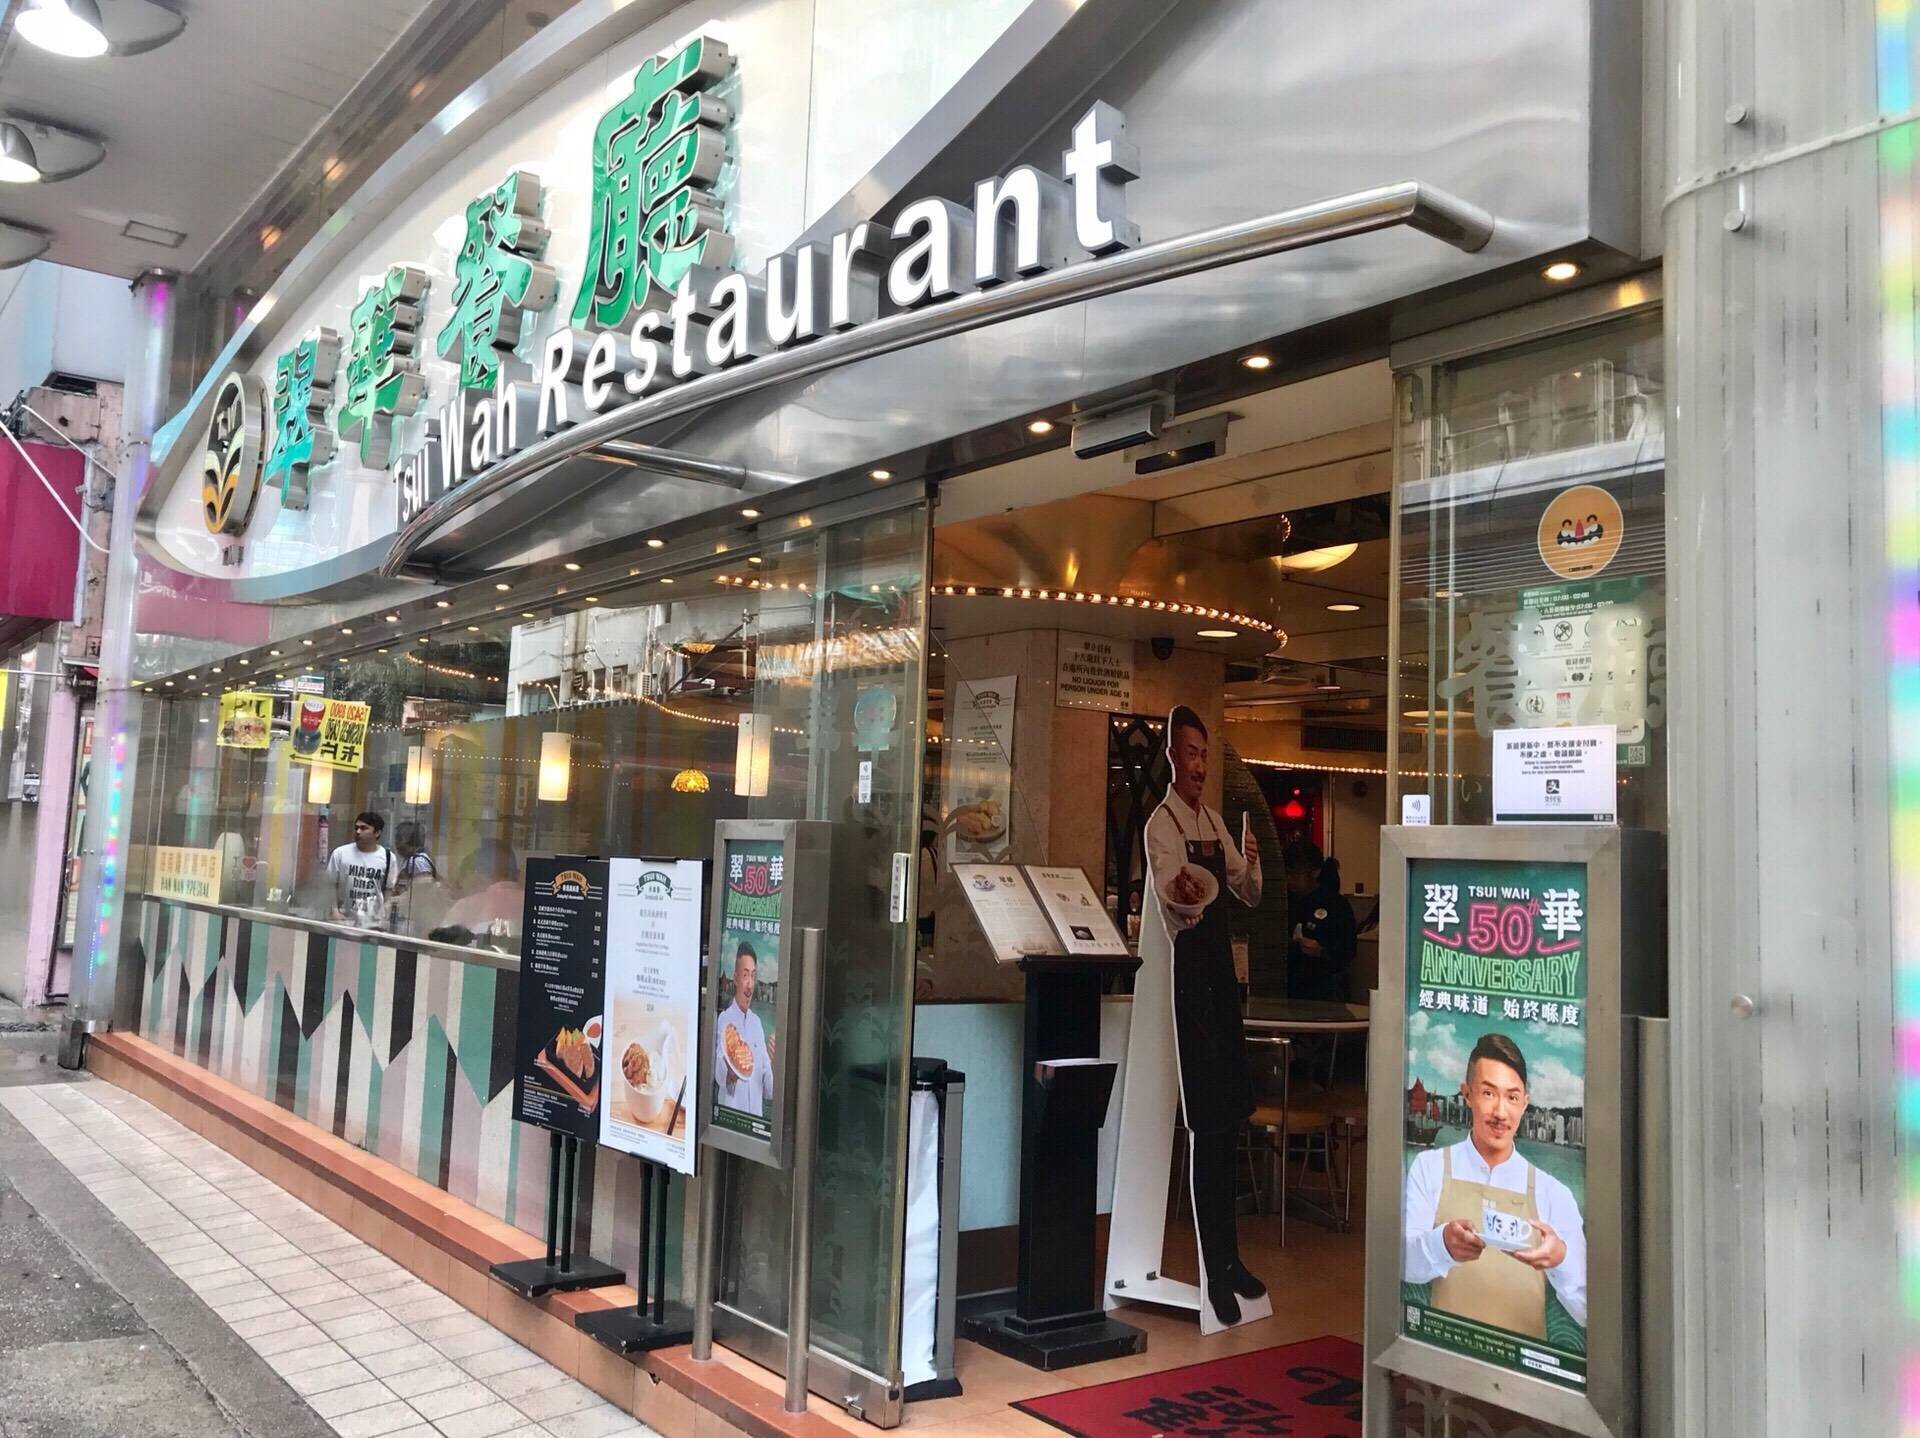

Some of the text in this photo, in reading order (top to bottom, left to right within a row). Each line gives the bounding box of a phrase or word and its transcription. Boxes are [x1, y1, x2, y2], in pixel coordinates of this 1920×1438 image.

[264, 36, 706, 508] 翠華餐廳
[393, 106, 1115, 532] Tsui Wah Restaurant
[1060, 683, 1086, 693] PERSON
[1087, 687, 1108, 696] UNDER
[1109, 690, 1122, 698] AGE
[1072, 676, 1120, 689] NO LIQUOR FOR
[729, 854, 744, 883] 翠
[769, 855, 784, 886] 華
[1423, 883, 1460, 933] 翠
[1467, 885, 1531, 900] TSUI WAH
[1540, 888, 1584, 941] 華
[1420, 940, 1581, 997] ANNIVERSARY
[1418, 989, 1489, 1017] 經典味道
